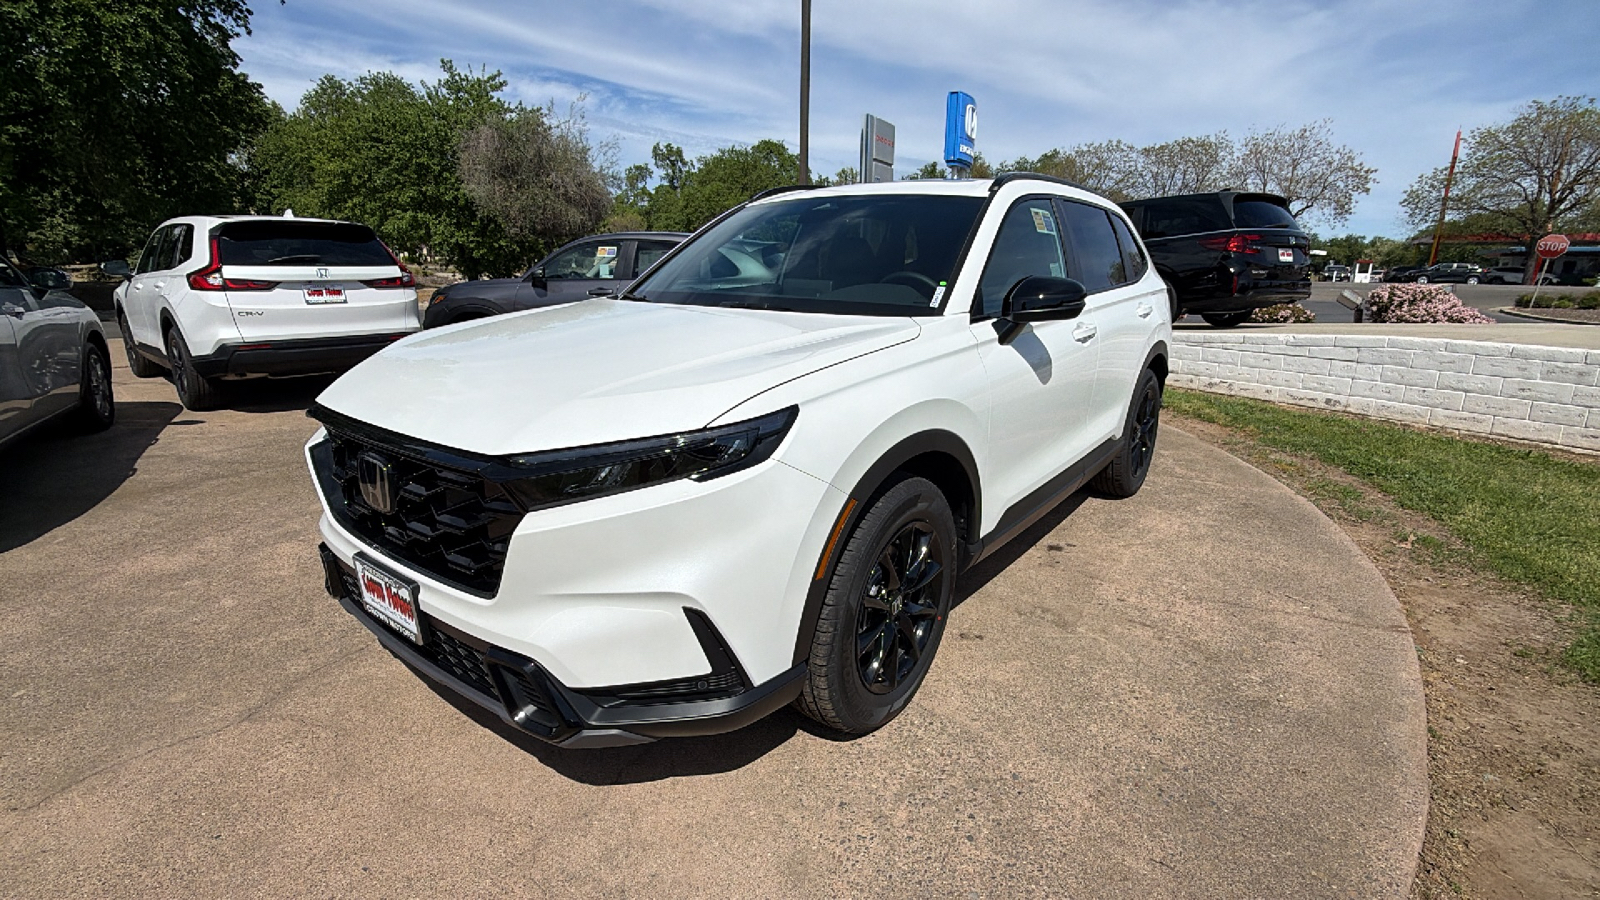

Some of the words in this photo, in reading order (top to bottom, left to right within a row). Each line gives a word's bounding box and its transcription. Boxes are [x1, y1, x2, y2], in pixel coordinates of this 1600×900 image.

[1538, 241, 1567, 251] STOP
[361, 571, 386, 604] Crown
[384, 581, 414, 622] Motors
[366, 604, 389, 624] CROWN
[389, 619, 416, 642] MOTORS
